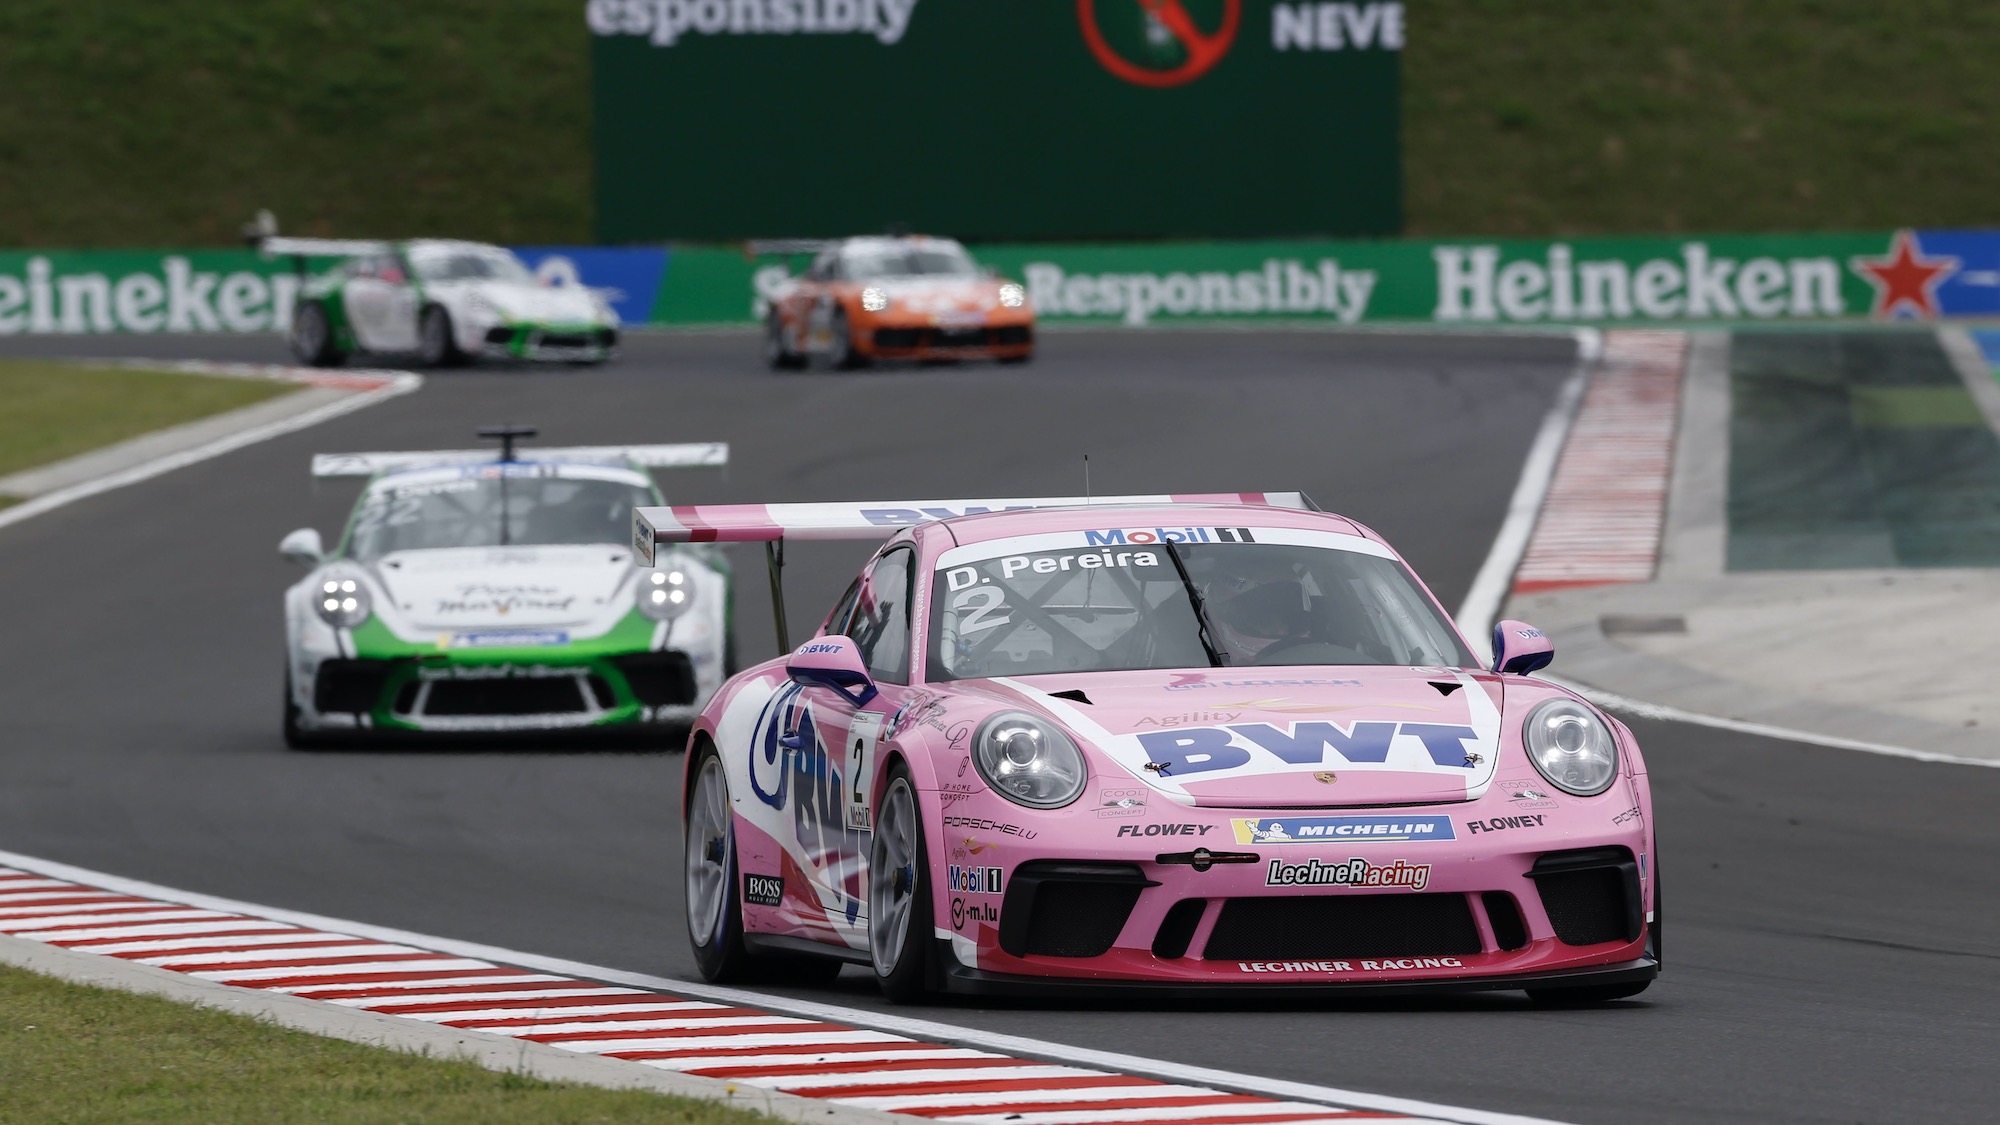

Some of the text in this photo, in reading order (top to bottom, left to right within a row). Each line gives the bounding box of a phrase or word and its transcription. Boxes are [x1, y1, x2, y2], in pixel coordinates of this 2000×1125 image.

[1434, 244, 1843, 319] Heineken
[1024, 264, 1377, 323] Responsibly
[859, 505, 1050, 525] BW
[1084, 528, 1210, 545] Mobil
[946, 549, 1159, 592] D. Pereira
[953, 586, 1011, 635] 2
[808, 644, 843, 654] BWT
[1133, 711, 1243, 728] Agility
[1136, 722, 1479, 778] BWT
[853, 738, 863, 803] 2
[952, 784, 972, 792] HOME
[1103, 789, 1145, 797] COOL
[1501, 780, 1536, 790] COOL
[1101, 808, 1143, 817] CONCEPT
[1520, 801, 1558, 810] CONCEPT
[944, 817, 1038, 840] PORSCHE.LU
[1117, 823, 1213, 838] FLOWEY
[1298, 823, 1435, 838] MICHELIN
[1467, 814, 1545, 835] FLOWEY
[951, 847, 967, 860] Agility
[950, 865, 984, 892] Mobil
[749, 877, 781, 898] BOSS
[1239, 956, 1463, 973] LECHNER RACING
